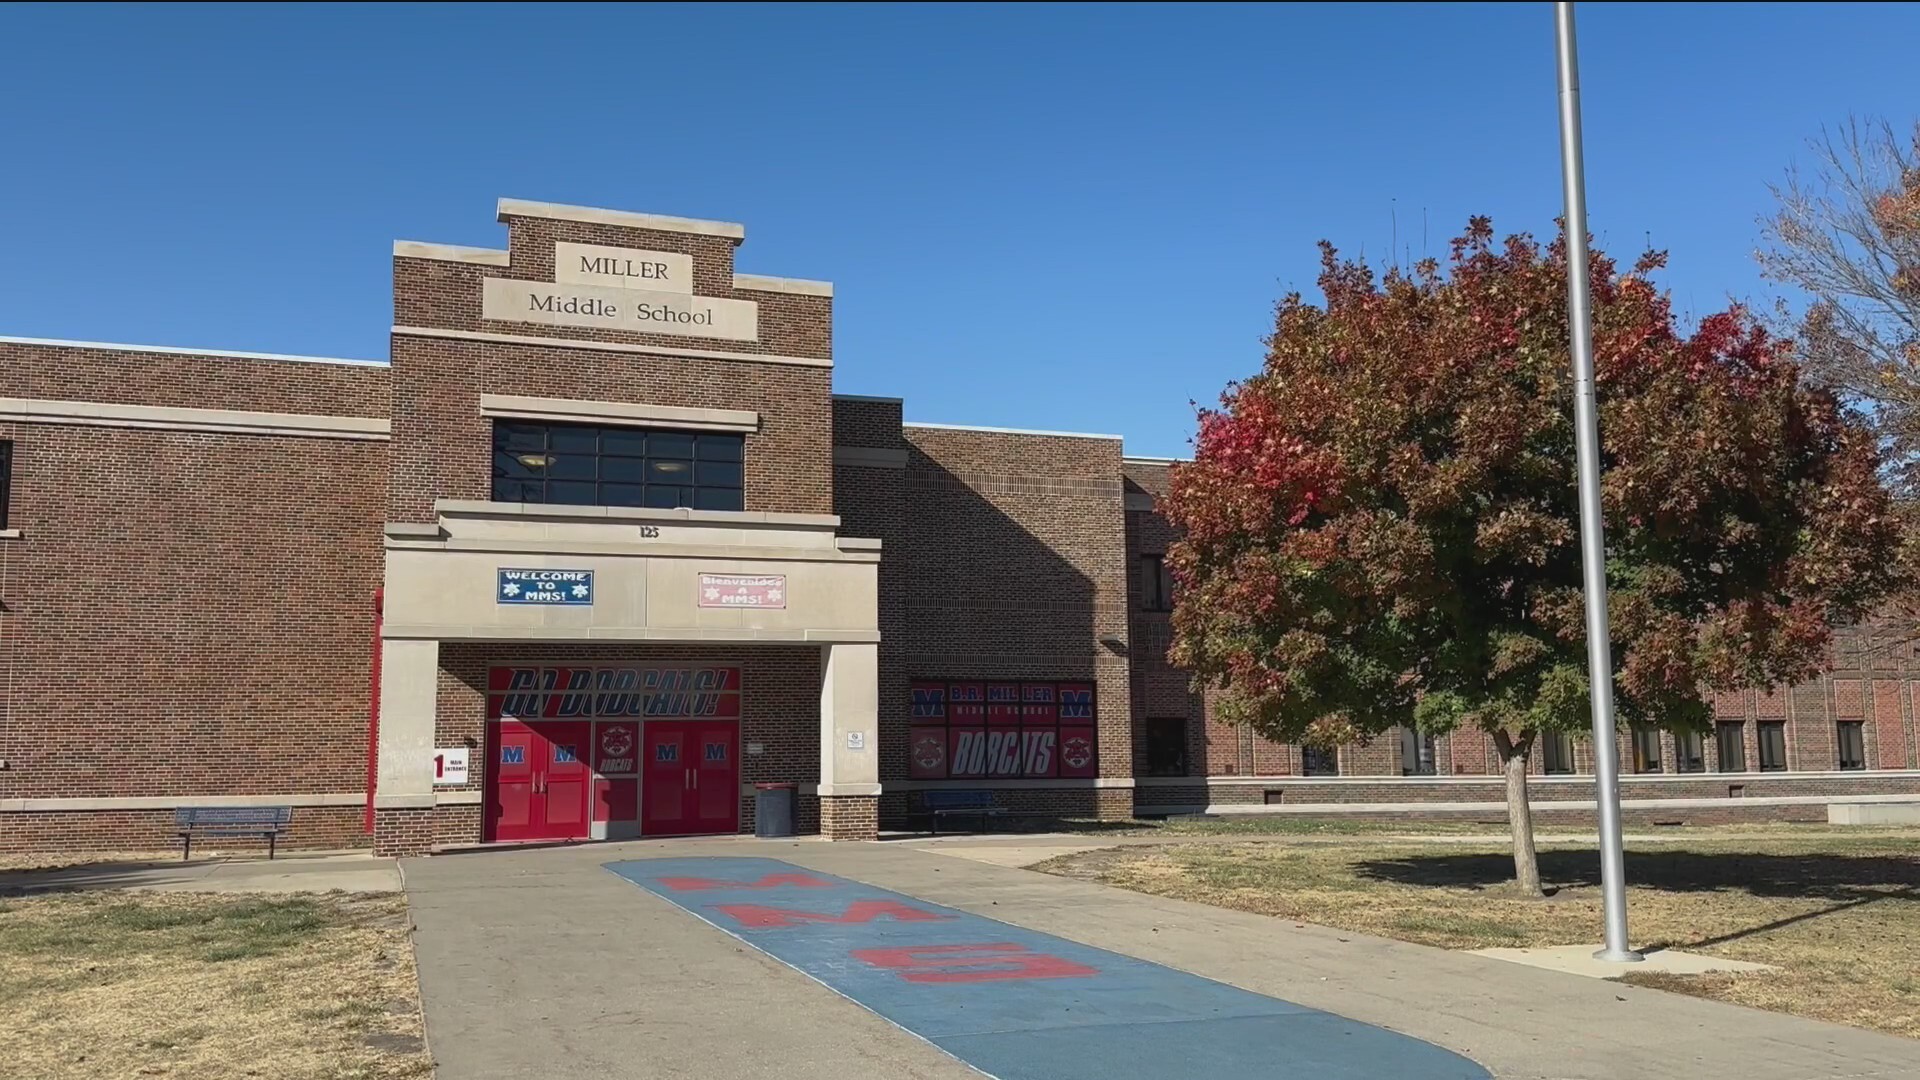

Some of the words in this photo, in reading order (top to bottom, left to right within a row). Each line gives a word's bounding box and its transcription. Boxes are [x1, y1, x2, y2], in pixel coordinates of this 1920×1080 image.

[580, 256, 669, 280] MILLER
[529, 294, 617, 318] Middle
[637, 303, 713, 326] School
[640, 526, 659, 539] 125
[505, 571, 587, 582] WELCOME
[536, 581, 556, 590] TO
[525, 591, 566, 601] MMS!
[721, 594, 763, 604] MMS!
[501, 668, 559, 716] GO
[987, 687, 1053, 702] MILLER
[912, 689, 945, 717] M
[1060, 690, 1092, 718] M
[501, 745, 525, 764] M
[554, 744, 577, 763] M
[656, 743, 679, 762] M
[705, 743, 728, 760] M
[952, 731, 1057, 775] BOBCATS
[434, 754, 444, 778] 1
